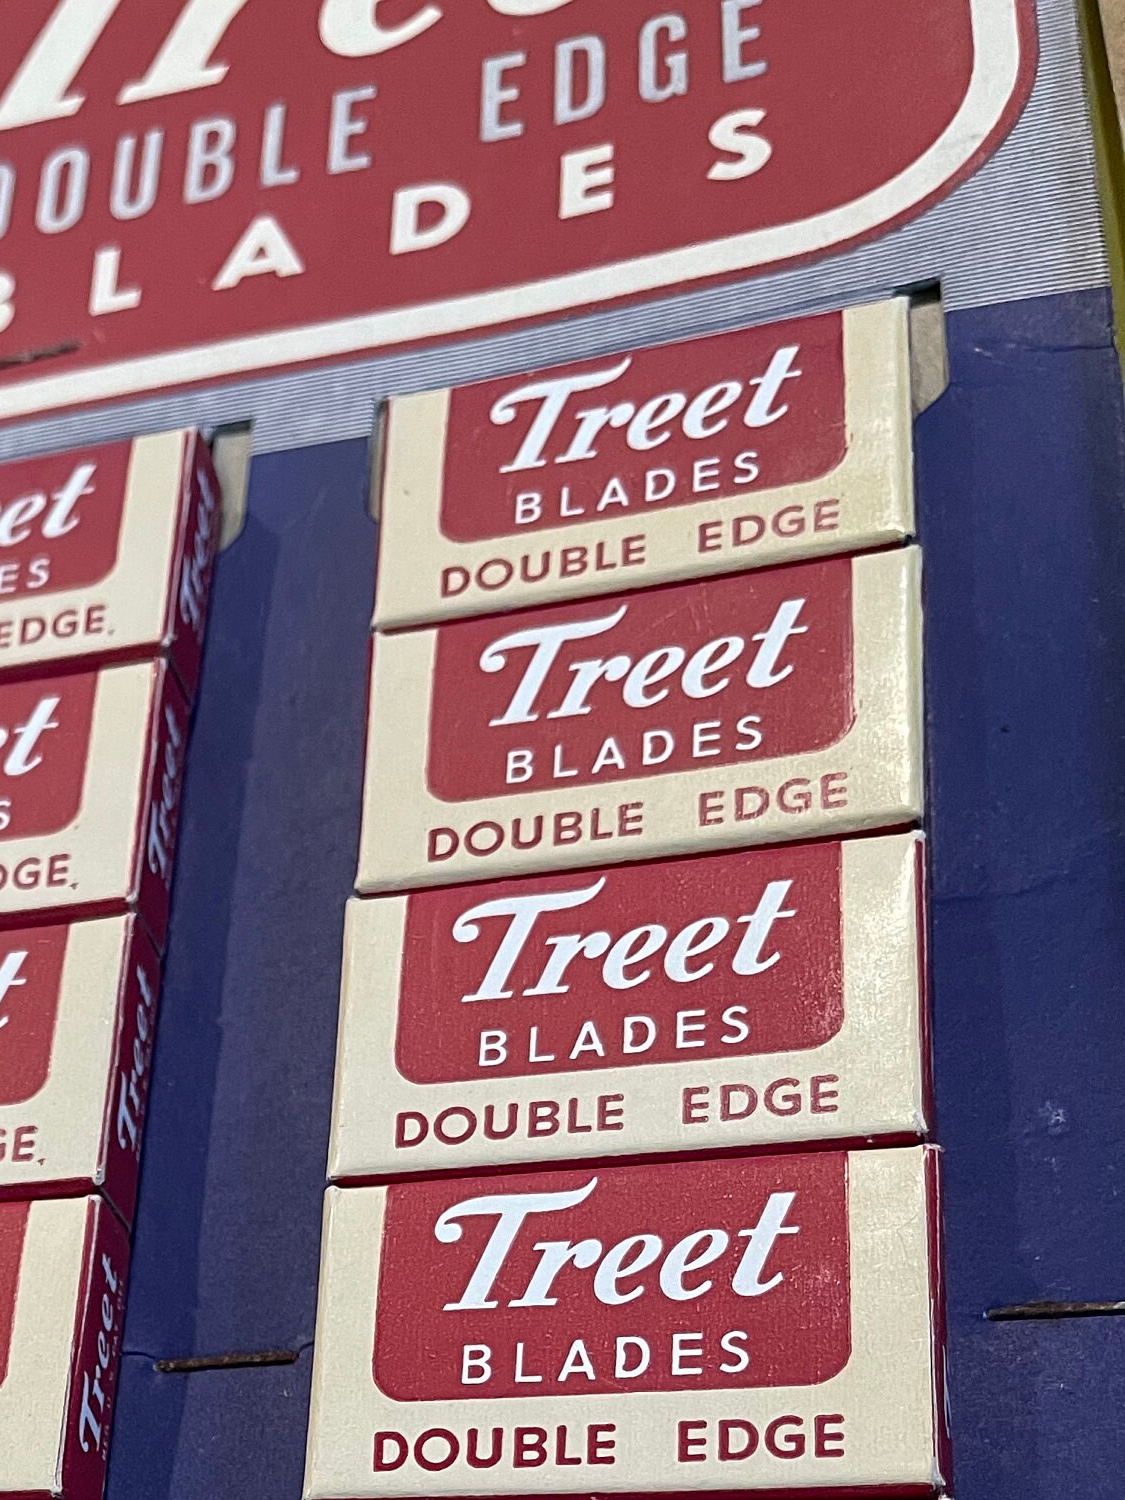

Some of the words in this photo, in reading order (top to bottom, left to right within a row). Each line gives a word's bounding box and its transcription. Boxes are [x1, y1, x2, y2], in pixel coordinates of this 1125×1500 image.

[482, 0, 766, 141] EDGE
[491, 346, 801, 473] Treet
[516, 452, 758, 523] BLADES
[441, 535, 645, 598] DOUBLE
[698, 499, 839, 553] EDGE
[480, 599, 808, 726] Treet
[506, 716, 762, 783] BLADES
[428, 802, 643, 862] DOUBLE
[699, 772, 847, 826] EDGE
[453, 877, 796, 1002] Treet
[479, 1006, 748, 1066] BLADES
[395, 1094, 624, 1148] DOUBLE
[682, 1074, 838, 1124] EDGE
[435, 1177, 799, 1310] Treet
[79, 1254, 116, 1452] Treet
[462, 1331, 749, 1384] BLADES
[373, 1424, 616, 1472] DOUBLE
[678, 1414, 844, 1462] EDGE
